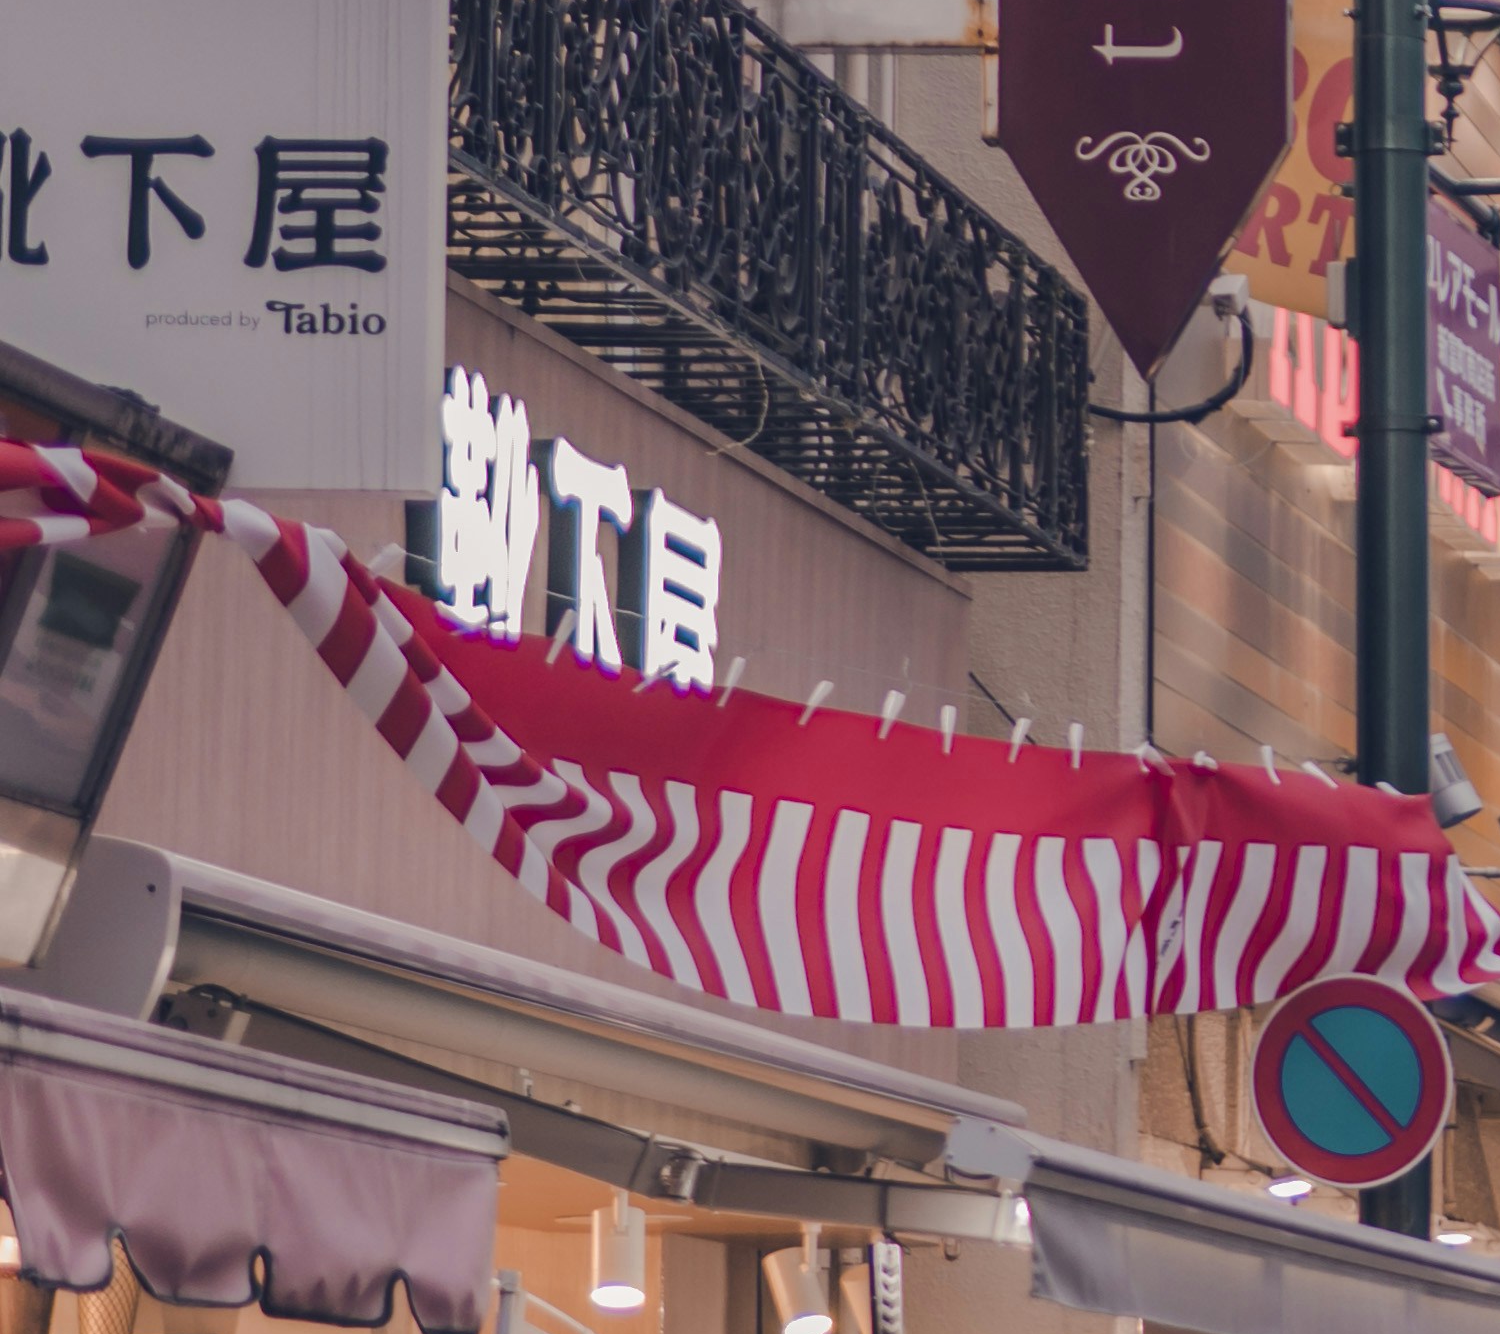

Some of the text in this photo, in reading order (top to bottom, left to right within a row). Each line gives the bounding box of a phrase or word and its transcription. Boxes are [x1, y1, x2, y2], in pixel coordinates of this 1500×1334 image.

[1239, 183, 1356, 280] RT
[146, 299, 387, 336] produced by Tabio
